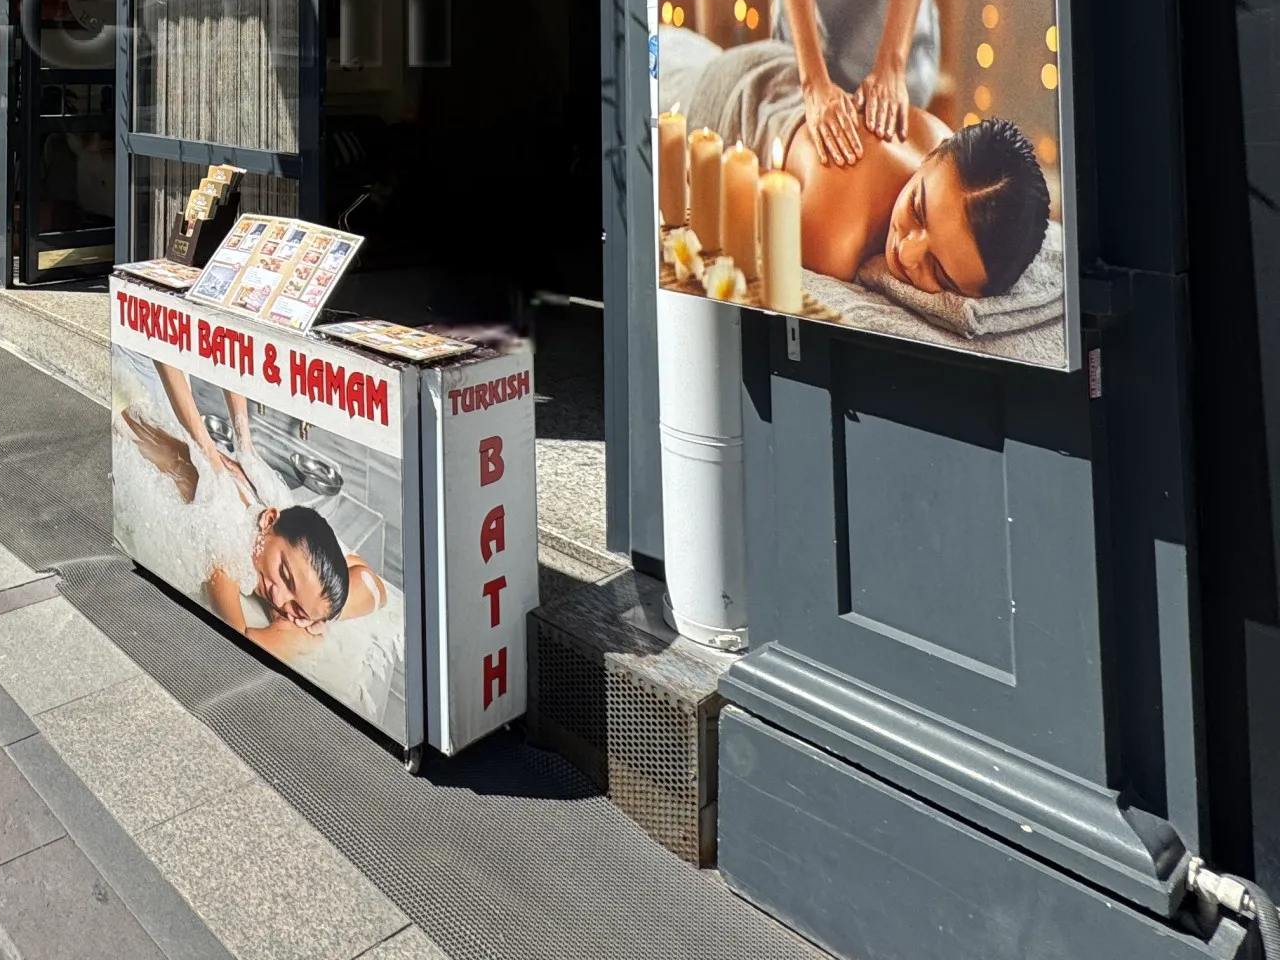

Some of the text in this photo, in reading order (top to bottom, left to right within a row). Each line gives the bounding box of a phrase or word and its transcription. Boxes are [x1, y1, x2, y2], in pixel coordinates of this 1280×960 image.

[116, 291, 389, 426] TURKISH BATH & HAMAM
[448, 370, 530, 416] TURKISH
[479, 435, 508, 711] BATH
